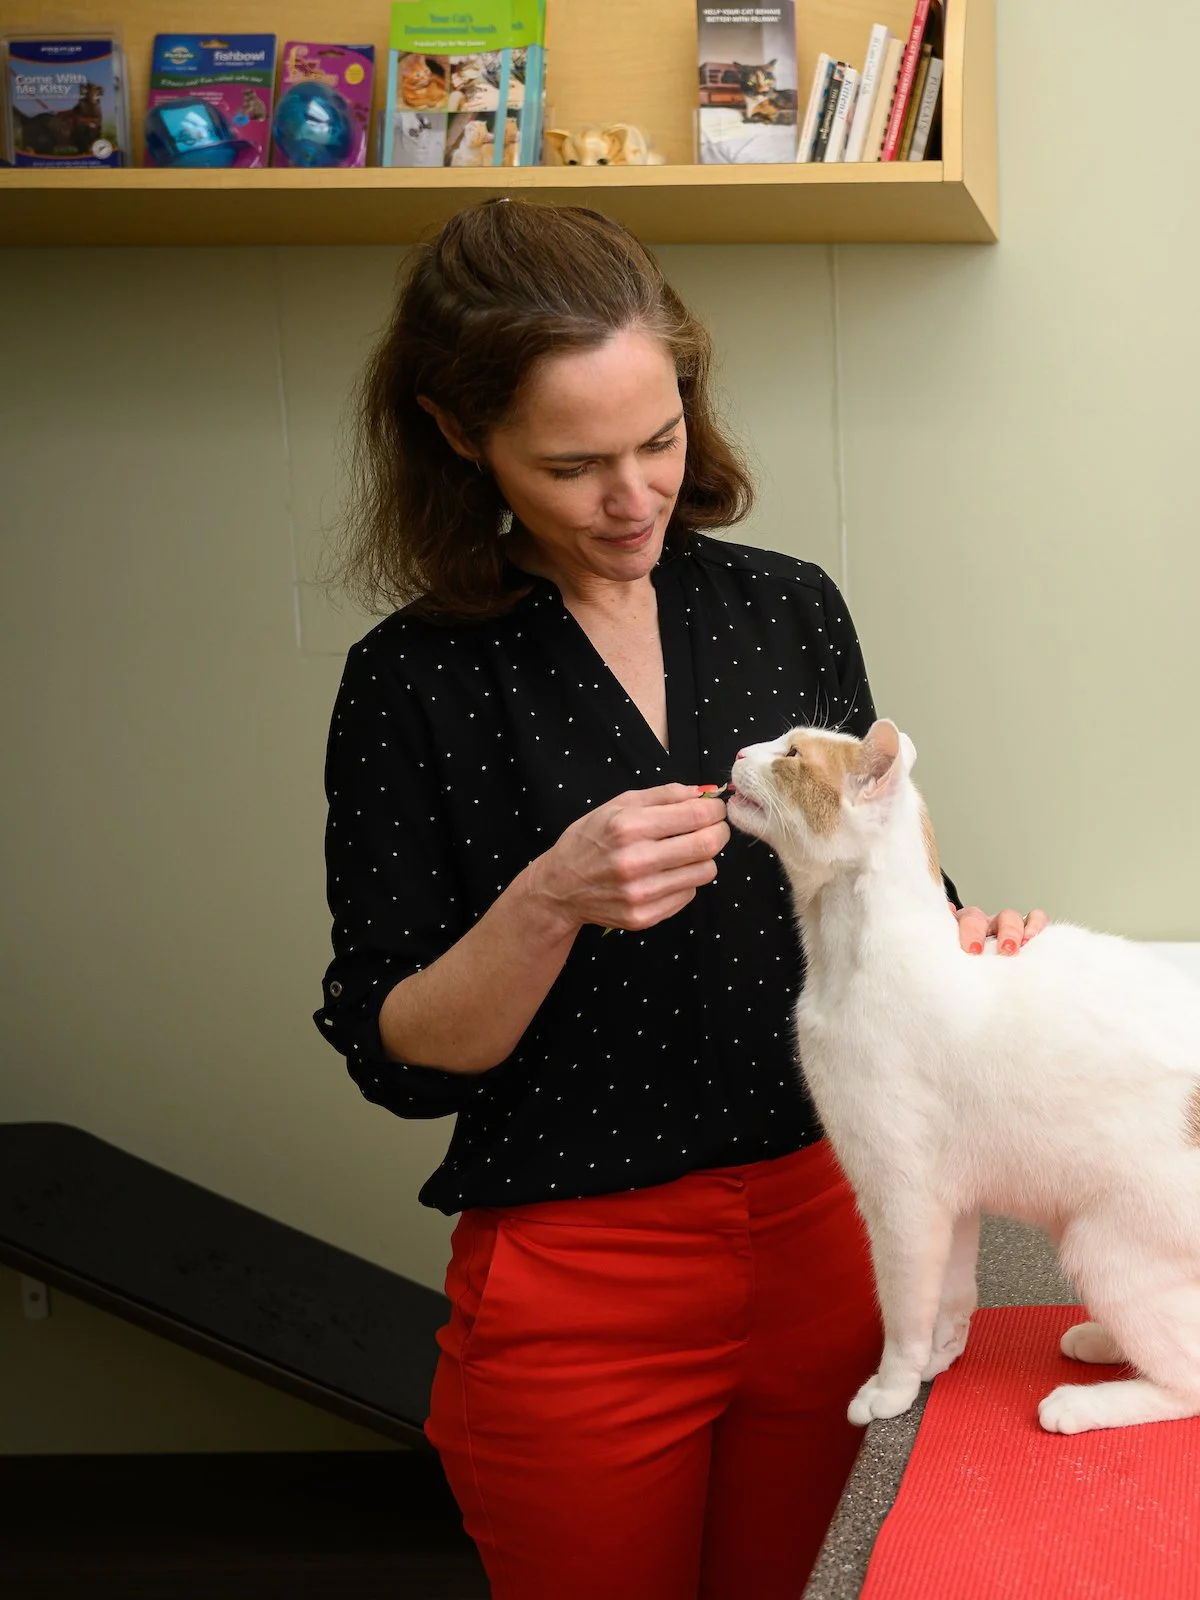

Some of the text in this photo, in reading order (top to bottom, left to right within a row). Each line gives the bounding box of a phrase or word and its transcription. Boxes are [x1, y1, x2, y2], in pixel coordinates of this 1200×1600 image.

[214, 51, 265, 62] fishbowl
[16, 73, 87, 85] Come With
[16, 85, 71, 96] Me Kitty
